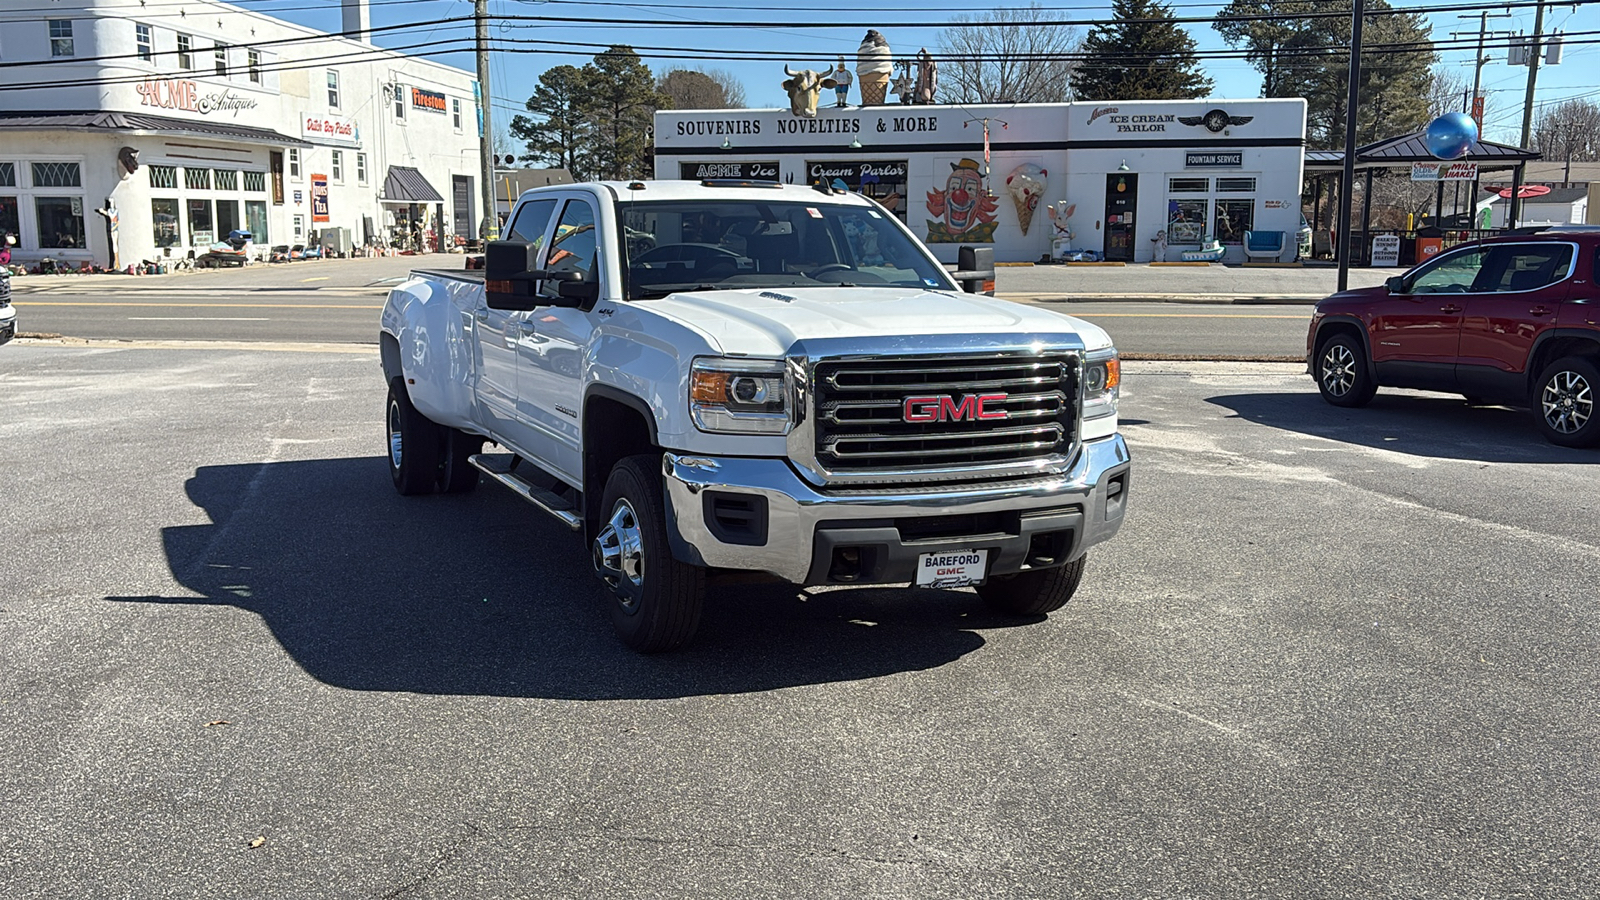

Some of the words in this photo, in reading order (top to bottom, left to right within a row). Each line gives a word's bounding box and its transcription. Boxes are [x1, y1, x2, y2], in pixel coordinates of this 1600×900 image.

[136, 75, 198, 112] ACME
[412, 88, 446, 110] Firestone
[677, 119, 761, 135] SOUVENIRS
[776, 118, 861, 134] NOVELTIES
[876, 118, 887, 133] &
[893, 117, 937, 132] MORE
[1109, 115, 1129, 124] ICE
[1131, 115, 1175, 123] CREAM
[307, 118, 322, 132] Dutch
[324, 120, 334, 136] Boy
[335, 121, 352, 136] Paints
[1117, 124, 1165, 133] PARLOR
[1187, 155, 1215, 164] FOUNTAIN
[1217, 154, 1240, 163] SERVICE
[697, 164, 742, 177] ACME
[750, 164, 777, 176] Ice
[811, 164, 853, 177] Cream
[860, 163, 905, 176] Parlor
[315, 201, 327, 213] TEA
[903, 394, 1008, 422] GMC
[925, 554, 980, 567] BAREFORD
[936, 566, 966, 575] GMC
